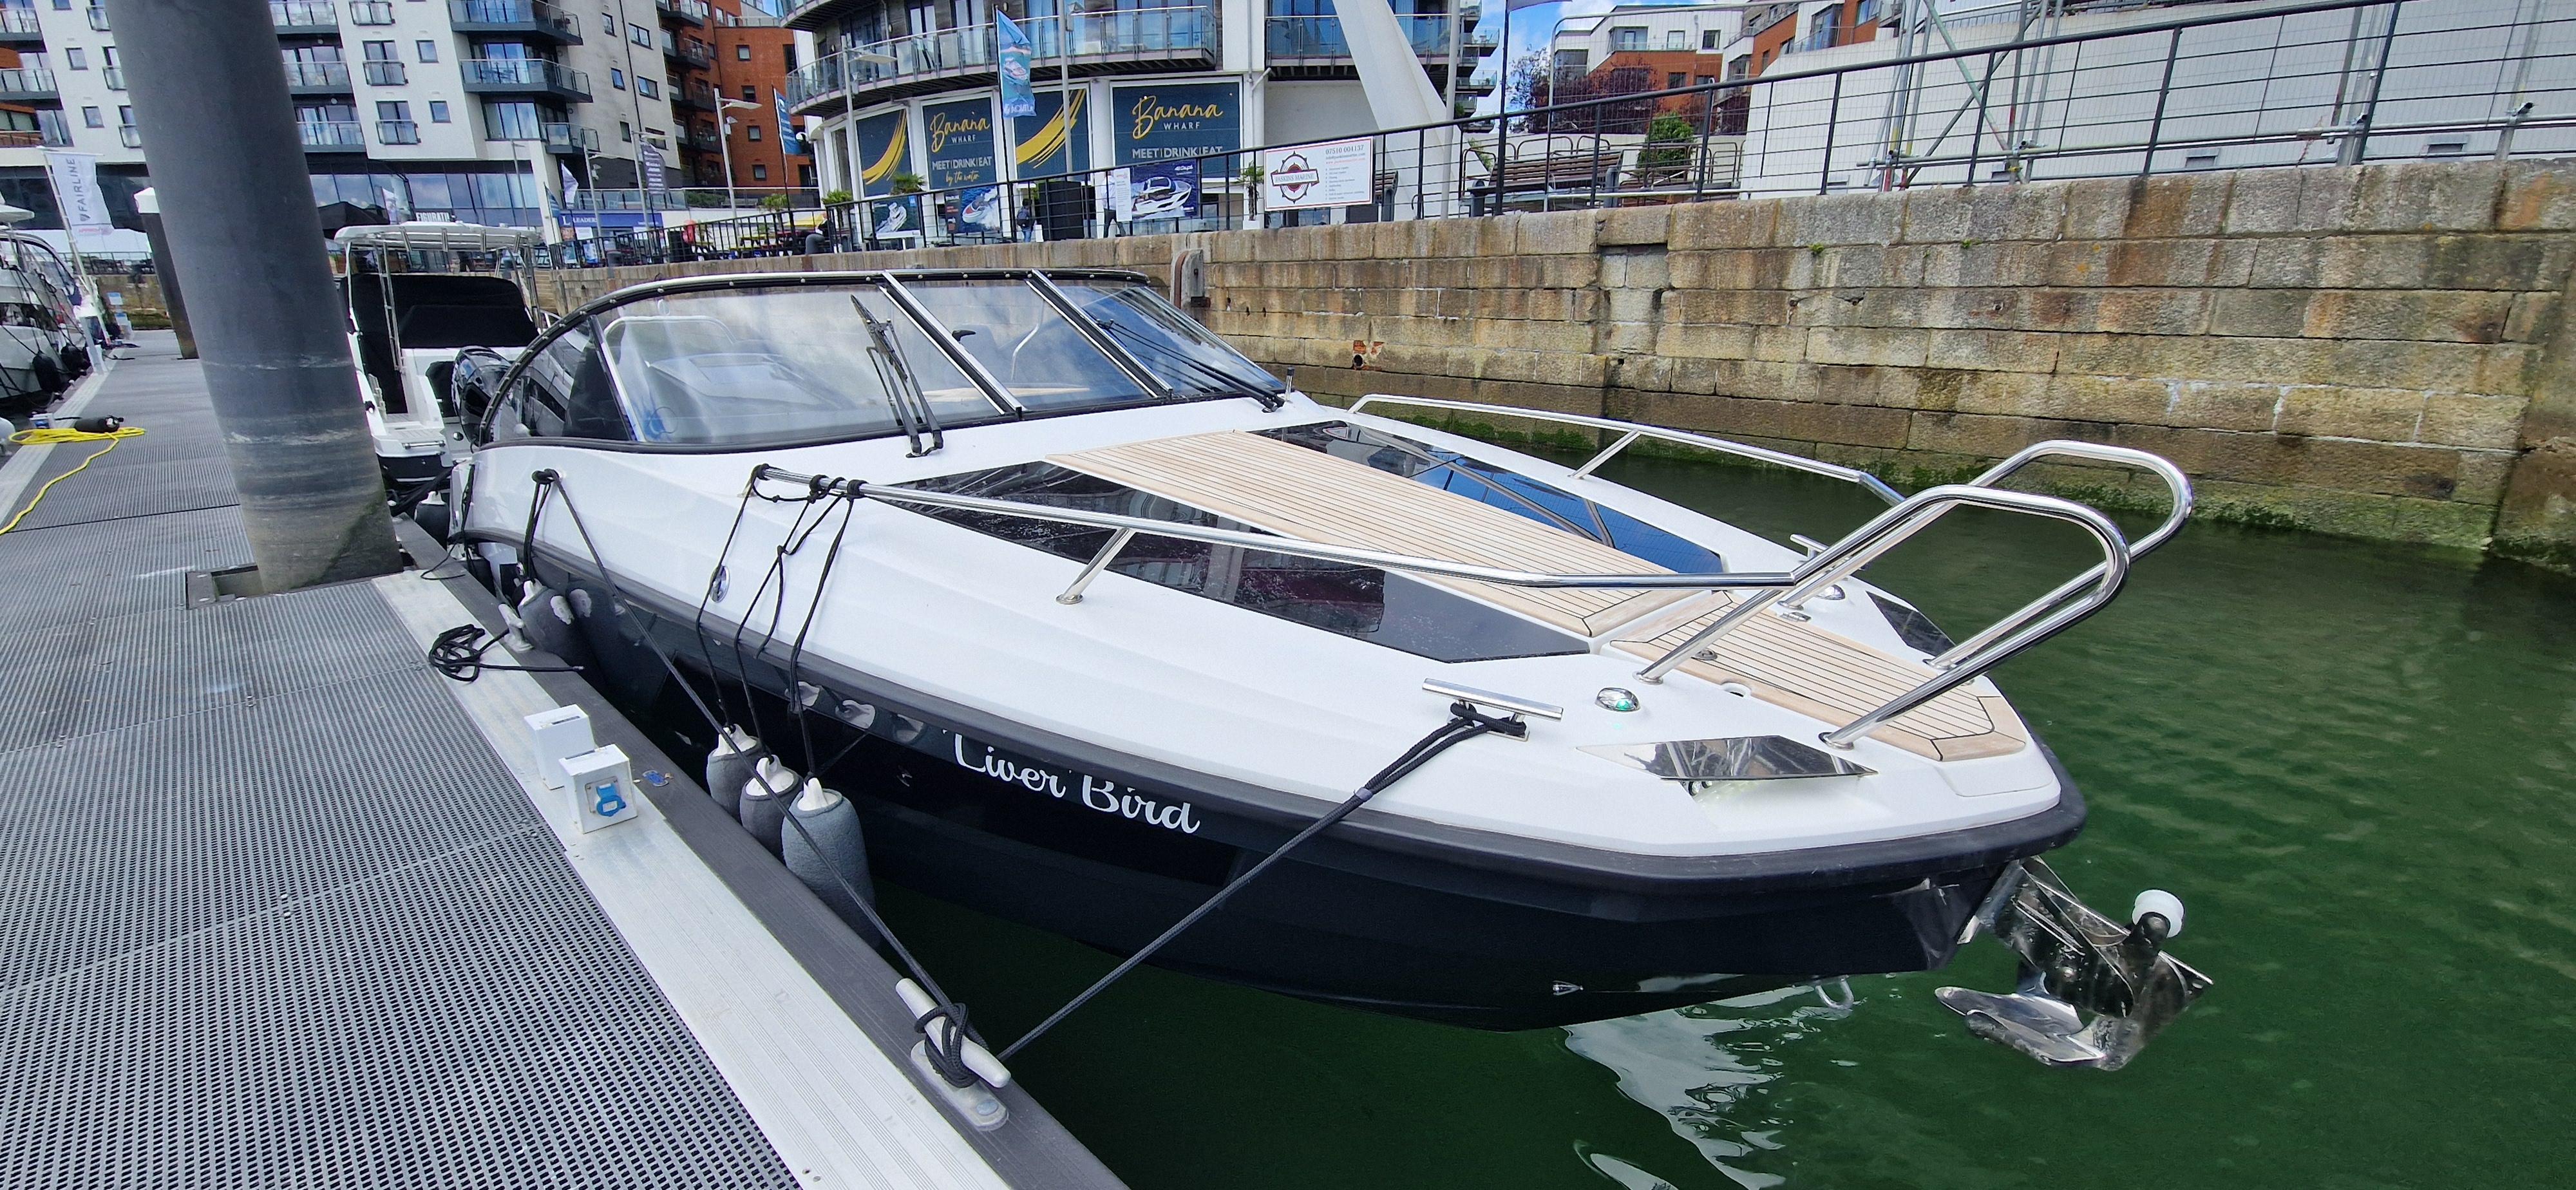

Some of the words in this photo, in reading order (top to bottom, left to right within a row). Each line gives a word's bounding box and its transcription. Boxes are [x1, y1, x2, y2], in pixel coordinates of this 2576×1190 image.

[929, 112, 990, 153] Banana
[1132, 95, 1224, 139] Banana
[1163, 121, 1200, 130] WHARF
[951, 134, 976, 143] WHARF
[1343, 144, 1364, 153] 001137
[66, 158, 88, 212] FAIRLINE
[942, 729, 1066, 798] Liver
[1069, 770, 1200, 833] Bird
